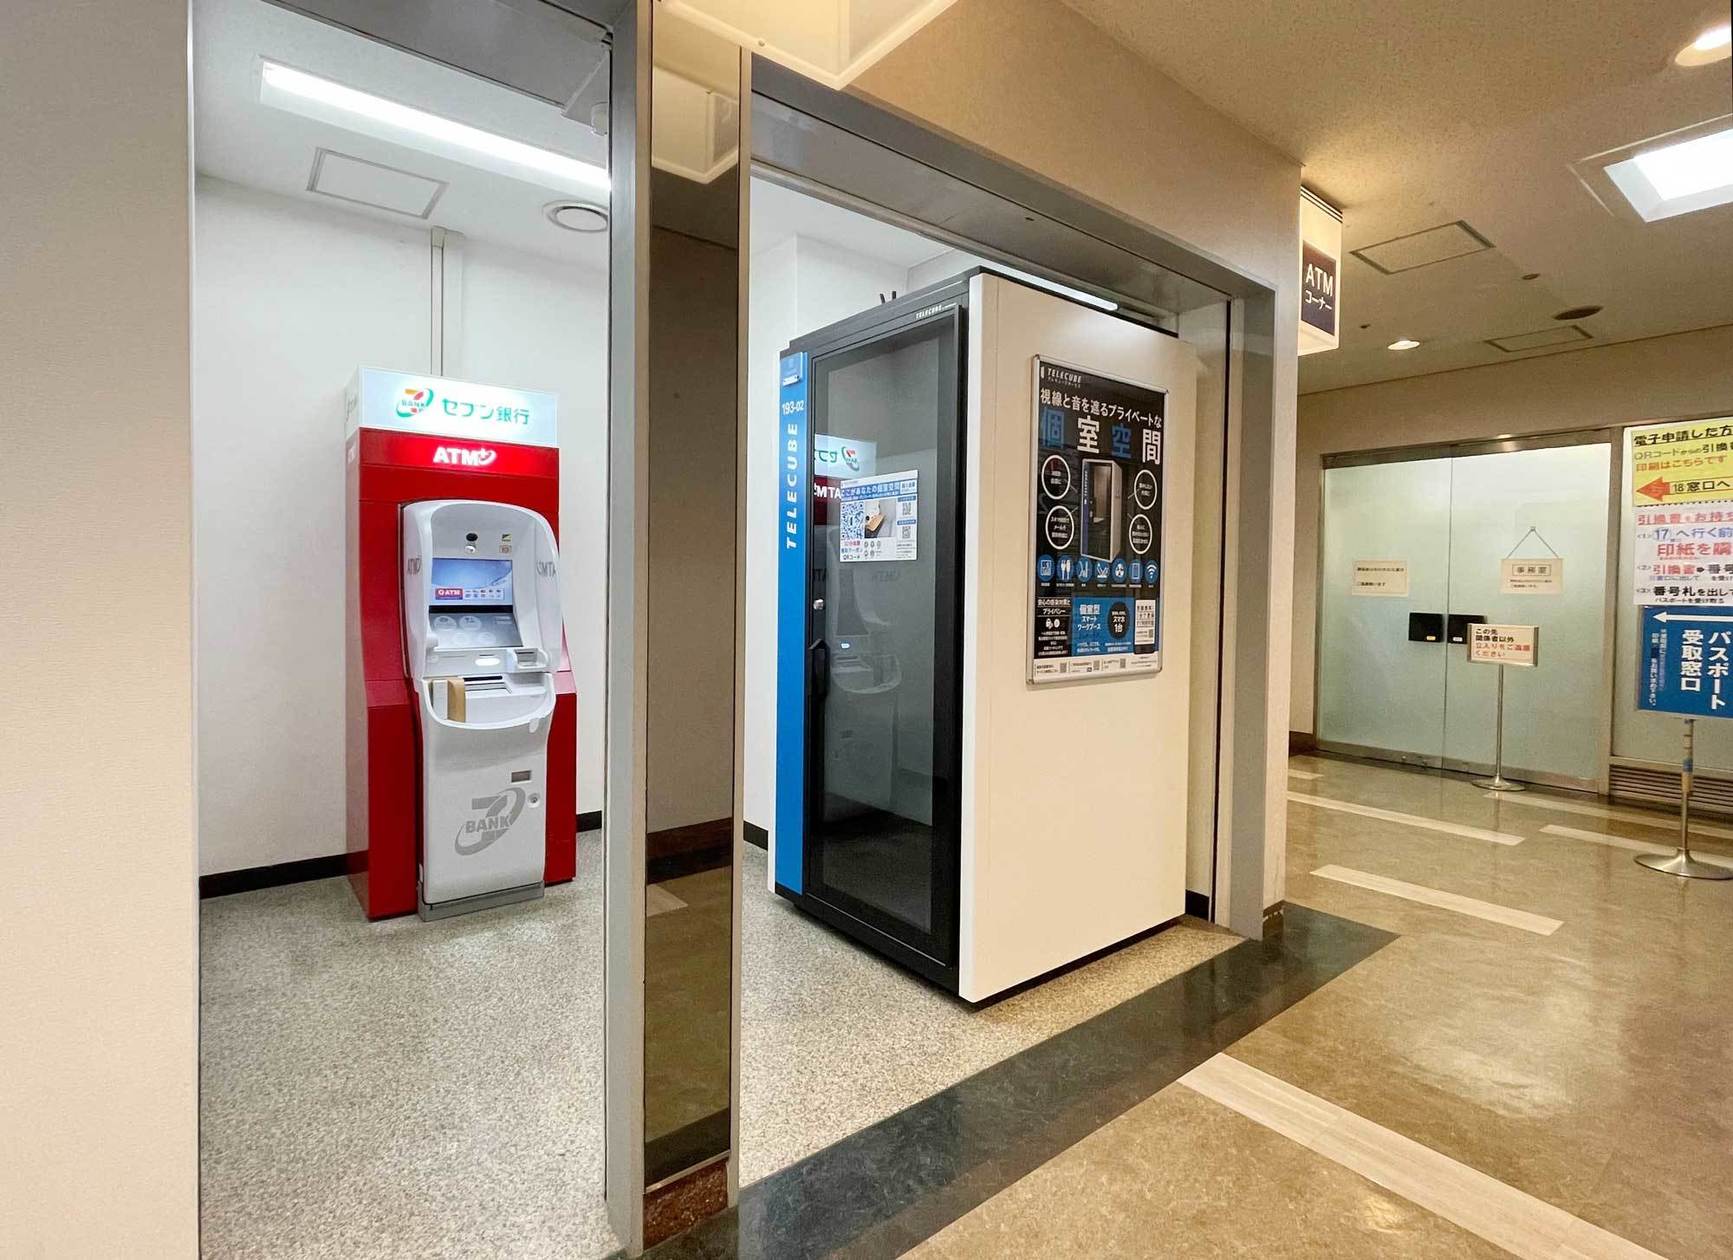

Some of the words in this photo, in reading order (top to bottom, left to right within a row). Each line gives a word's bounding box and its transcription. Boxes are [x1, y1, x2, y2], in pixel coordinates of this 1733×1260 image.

[1305, 263, 1333, 297] ATM
[1305, 289, 1333, 310] コーナー
[1047, 367, 1082, 384] TELECUBE
[781, 400, 805, 415] 193-02
[1040, 387, 1162, 429] 視線と音を遮るプライベートな
[1633, 425, 1733, 447] 電子申請した方
[433, 446, 479, 466] ATM
[1636, 455, 1728, 472] 印刷はこちらです
[786, 423, 798, 549] TELECUBE
[1655, 528, 1669, 540] 17
[1680, 629, 1704, 692] 受取窓口
[1706, 631, 1732, 710] パスポート
[465, 815, 511, 834] BANK
